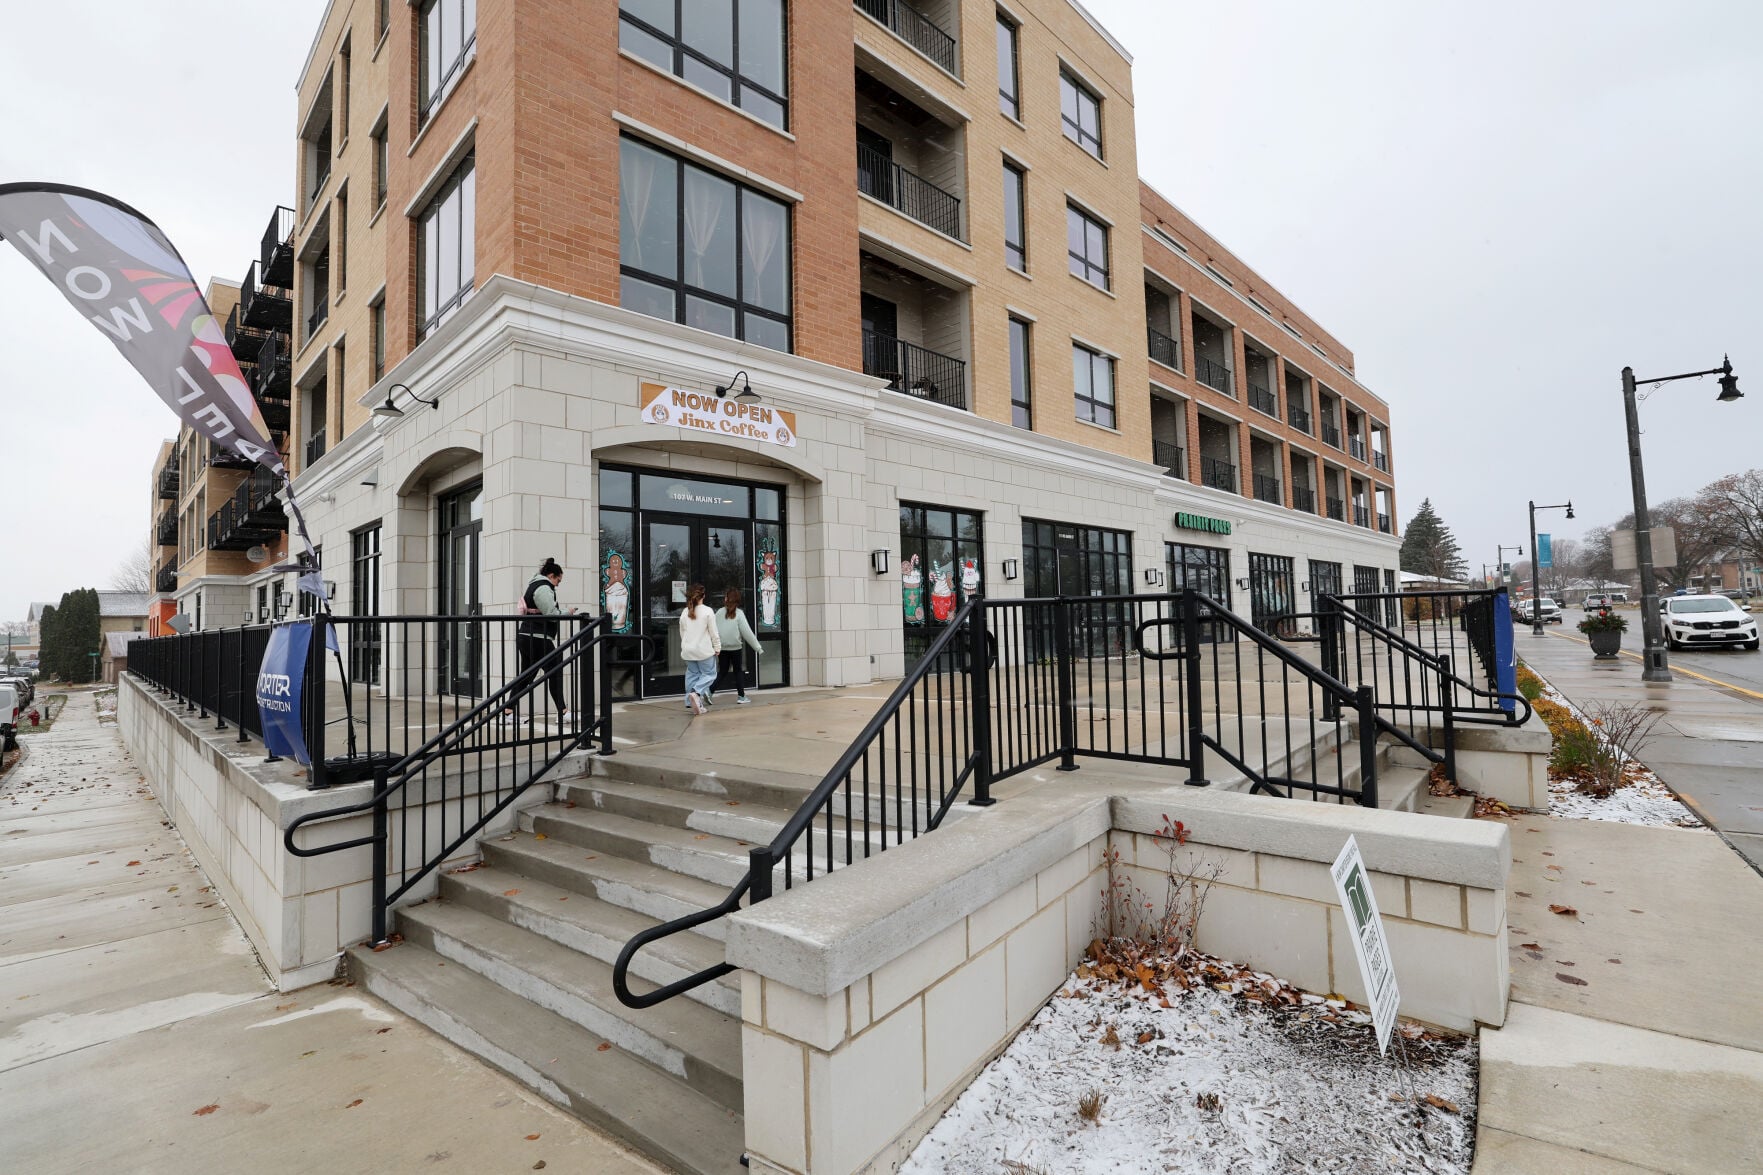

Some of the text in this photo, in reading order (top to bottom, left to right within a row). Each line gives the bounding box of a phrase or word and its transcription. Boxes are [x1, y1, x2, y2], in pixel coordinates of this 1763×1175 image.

[672, 389, 719, 414] NOW
[723, 400, 772, 424] OPEN
[678, 412, 716, 431] Jinx
[720, 419, 769, 440] Coffee
[695, 495, 713, 504] MAIN
